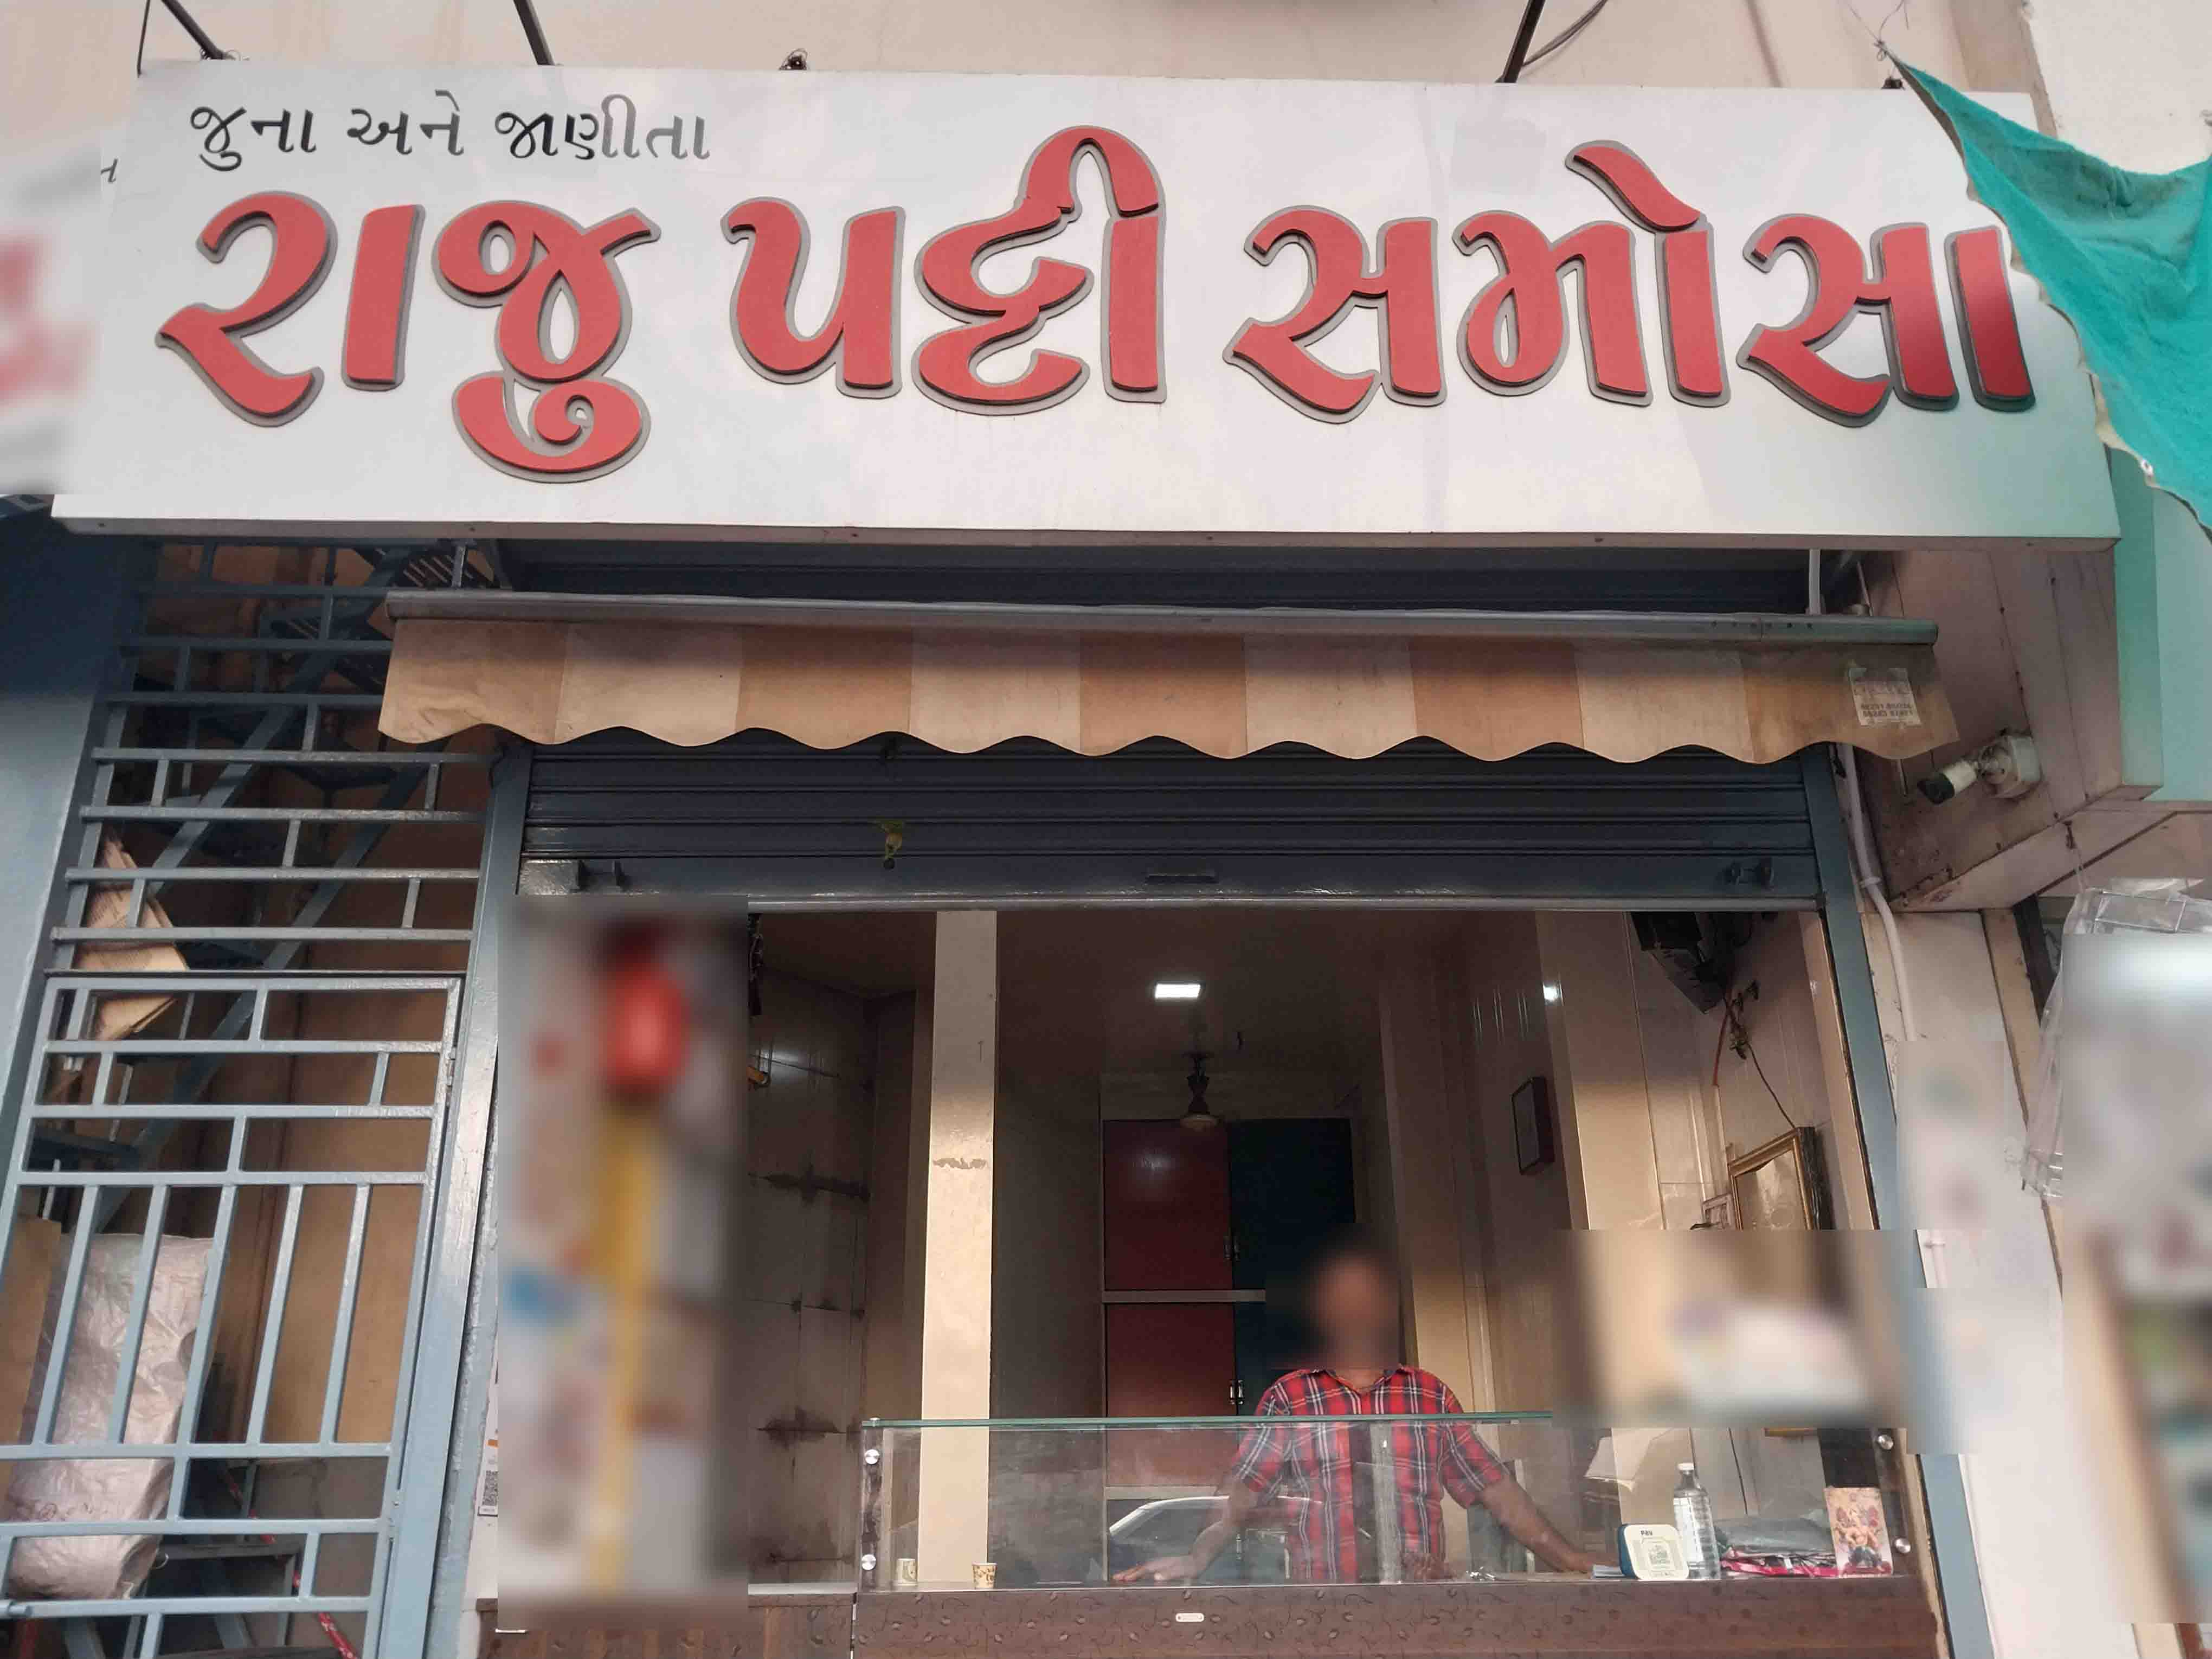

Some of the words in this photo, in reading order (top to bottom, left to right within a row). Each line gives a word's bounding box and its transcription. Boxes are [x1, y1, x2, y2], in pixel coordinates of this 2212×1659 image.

[190, 106, 317, 171] જુના
[346, 89, 465, 156] અને
[494, 94, 711, 160] જાણીતા
[155, 191, 661, 484] રાજુ
[721, 125, 1167, 416] પટ્ટી
[1222, 139, 2036, 428] સમોસા
